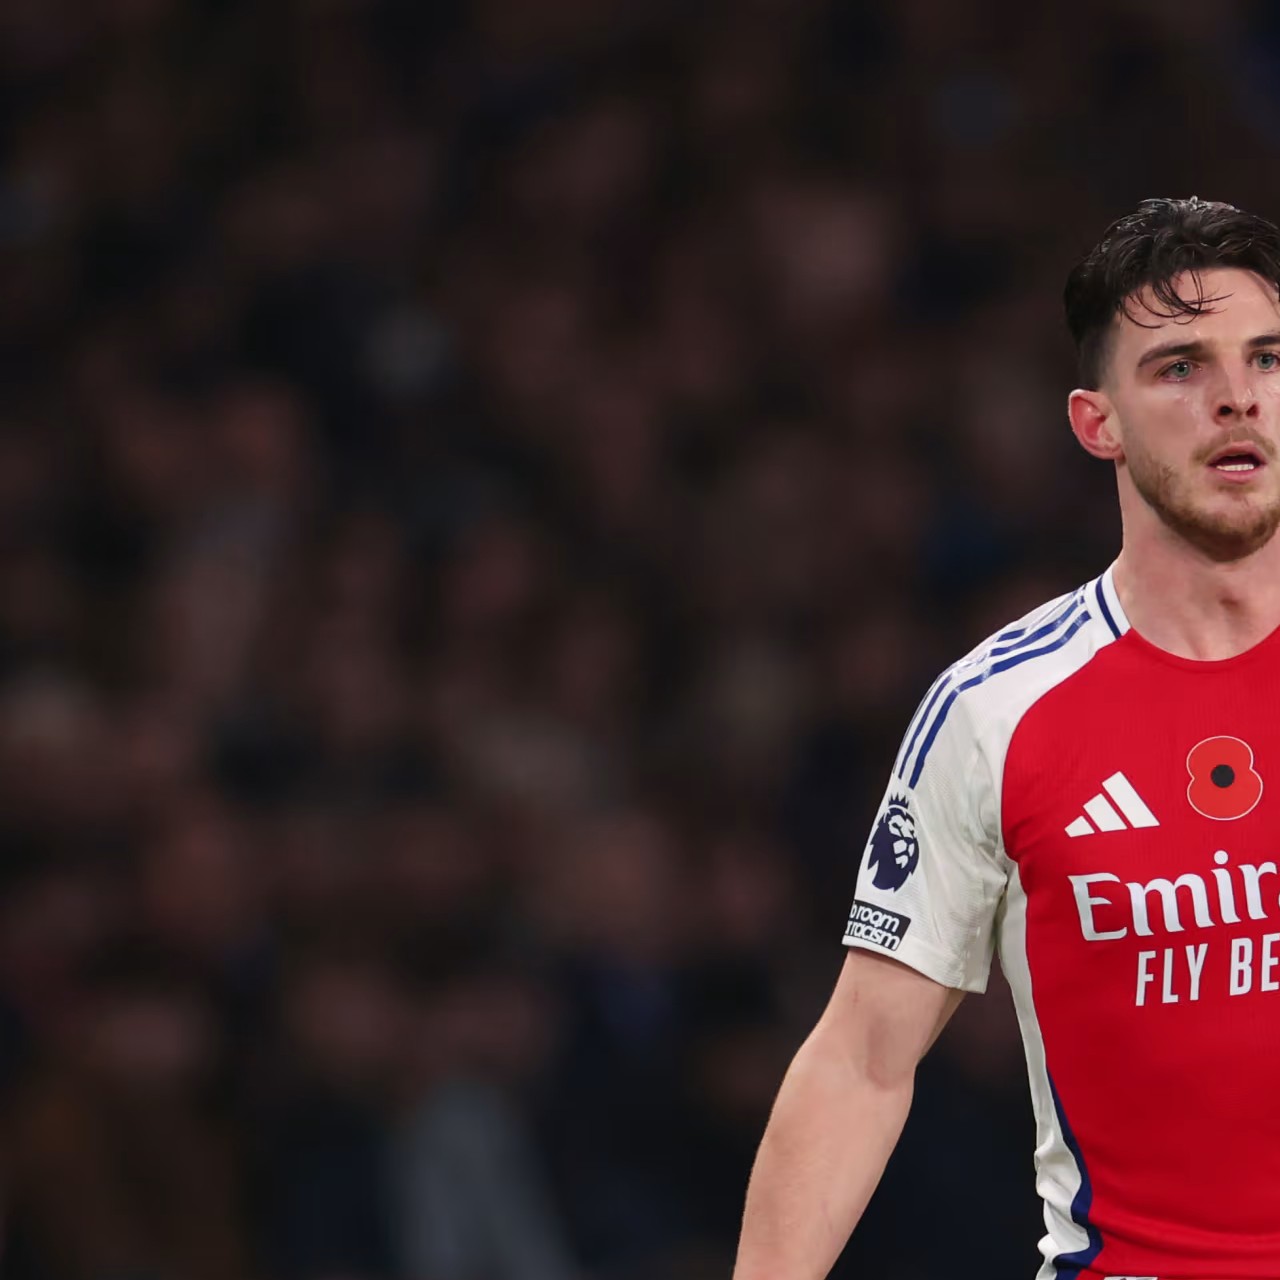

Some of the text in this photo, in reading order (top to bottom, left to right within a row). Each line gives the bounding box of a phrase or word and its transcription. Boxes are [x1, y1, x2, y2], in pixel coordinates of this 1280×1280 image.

[856, 905, 900, 933] room
[850, 922, 900, 950] racism
[1135, 943, 1208, 1007] FLY
